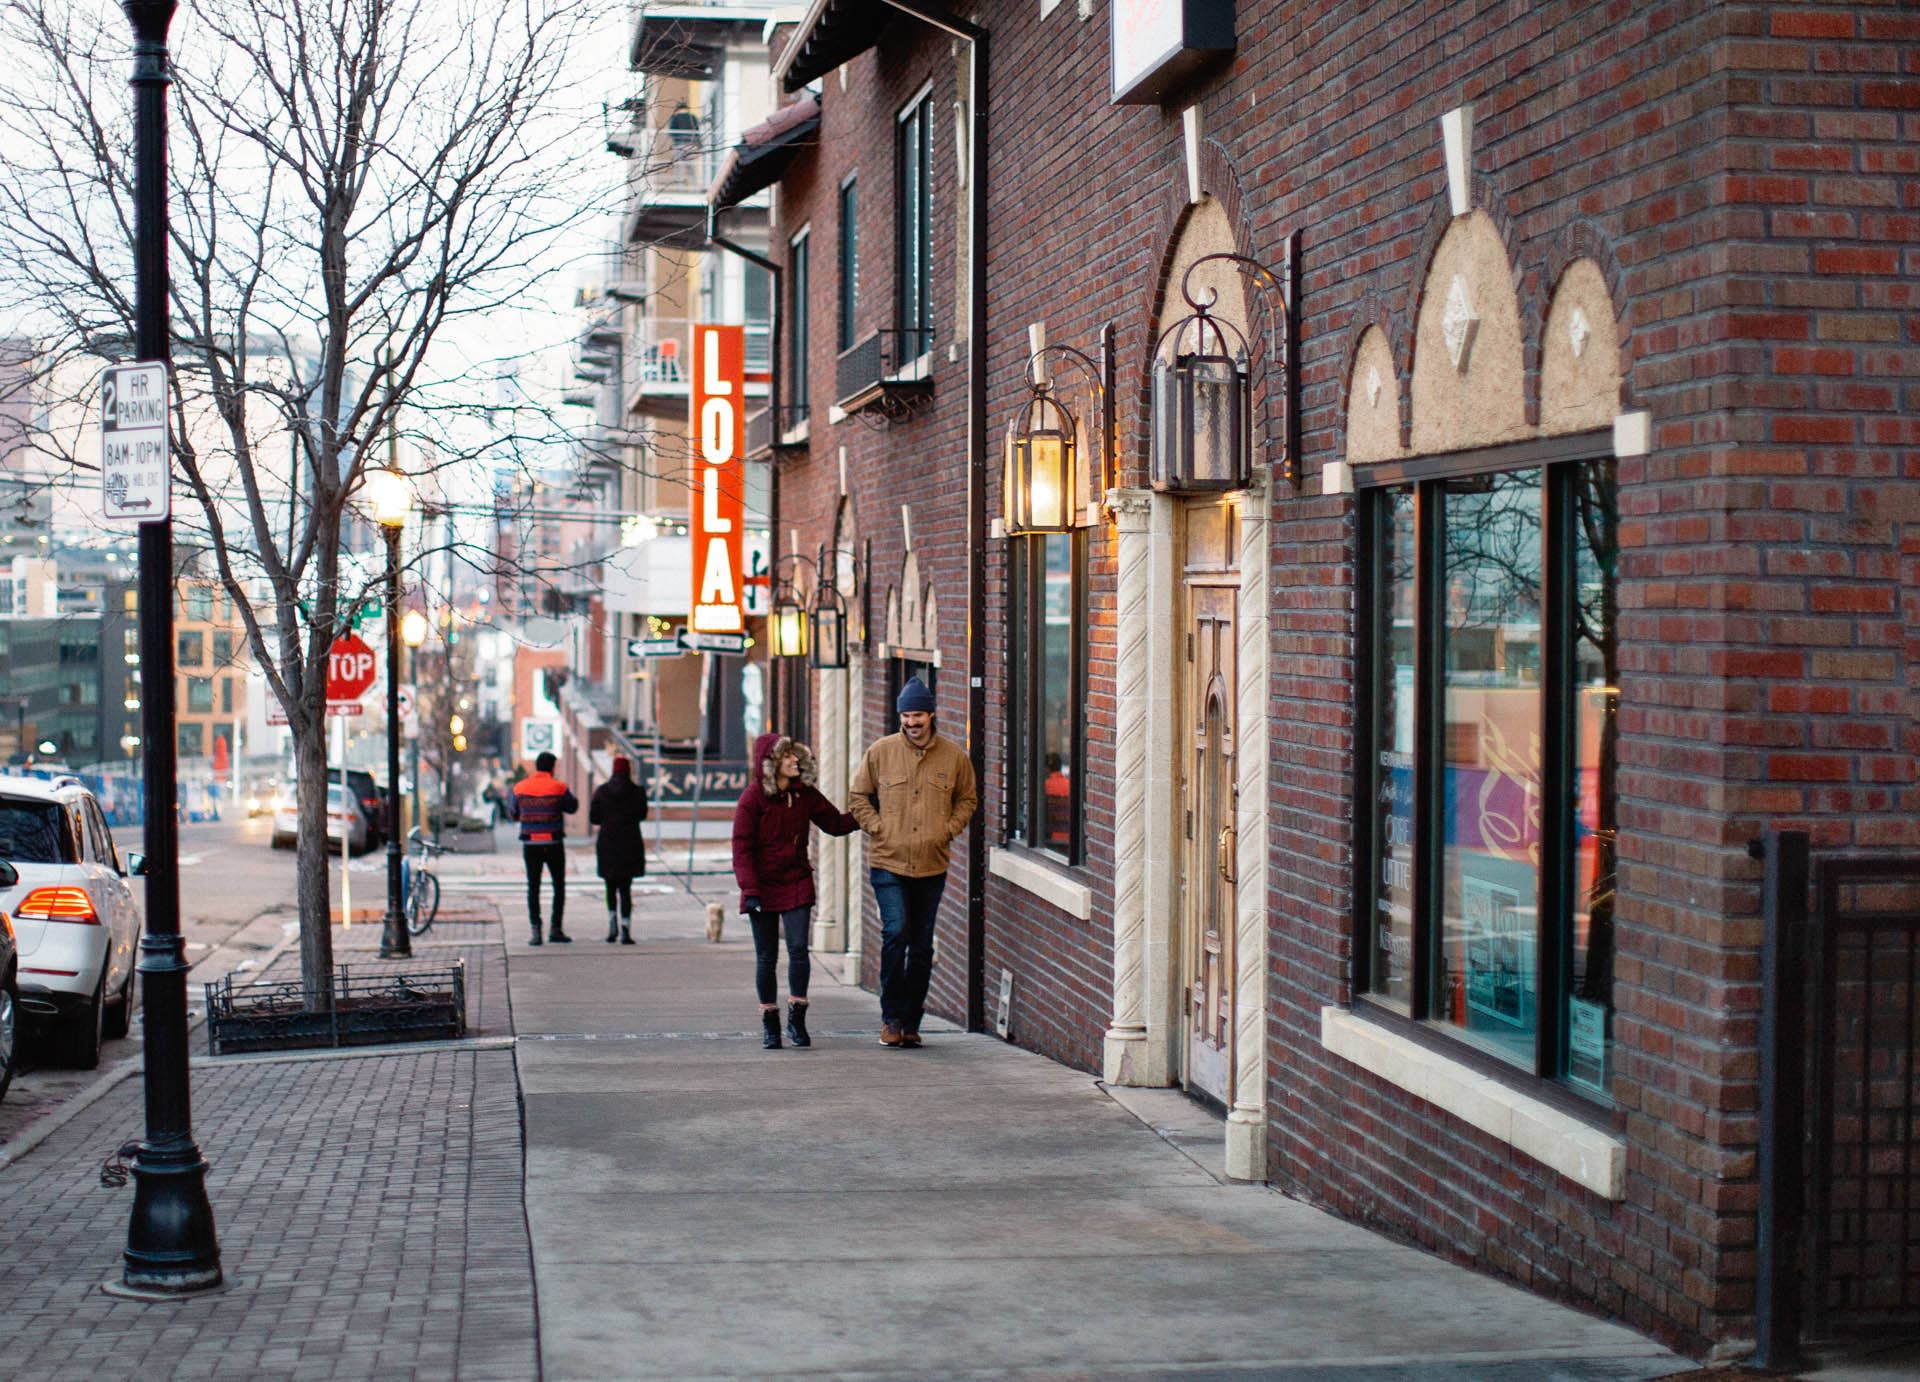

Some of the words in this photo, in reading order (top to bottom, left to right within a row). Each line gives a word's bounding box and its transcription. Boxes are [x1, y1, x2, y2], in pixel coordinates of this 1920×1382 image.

[103, 380, 116, 421] 2
[130, 373, 149, 397] HR
[117, 399, 162, 425] PARKING
[701, 330, 734, 603] LOLA
[329, 653, 373, 682] TOP
[684, 771, 747, 791] MIZU
